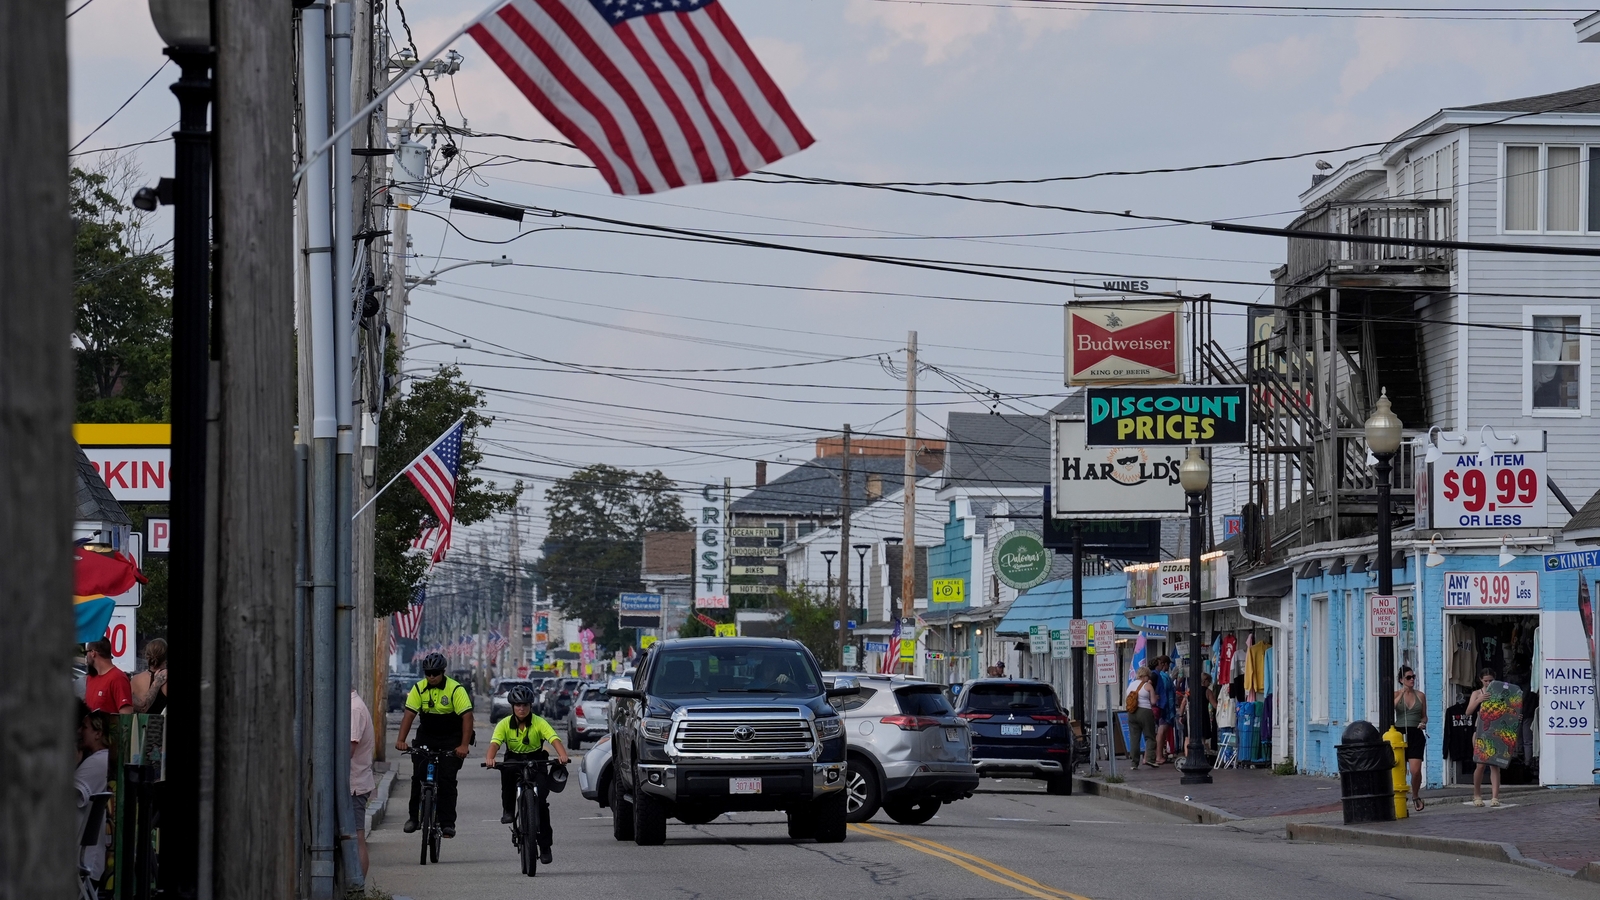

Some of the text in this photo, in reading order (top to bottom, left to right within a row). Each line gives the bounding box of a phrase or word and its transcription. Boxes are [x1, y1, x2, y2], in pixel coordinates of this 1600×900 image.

[1103, 280, 1149, 291] WINES
[1077, 334, 1171, 350] Budweiser
[1091, 396, 1240, 425] DISCOUNT
[1117, 414, 1215, 440] PRICES
[1491, 454, 1524, 466] ITEM
[1443, 468, 1538, 512] $9.99
[1459, 514, 1521, 526] OR LESS
[702, 485, 719, 592] CREST
[1560, 551, 1598, 568] KINNEY
[1163, 575, 1183, 586] SOLD
[1174, 582, 1190, 591] HER
[1447, 586, 1531, 605] ITEM Less
[1449, 575, 1469, 589] ANY
[1473, 575, 1510, 604] $9.99
[697, 596, 727, 608] motel
[1373, 608, 1396, 616] PARKING
[867, 643, 888, 652] BROWN
[1545, 668, 1591, 680] MAINE
[1543, 685, 1595, 695] T-SHIRTS
[1550, 701, 1585, 710] ONLY
[1548, 716, 1588, 729] $2.99
